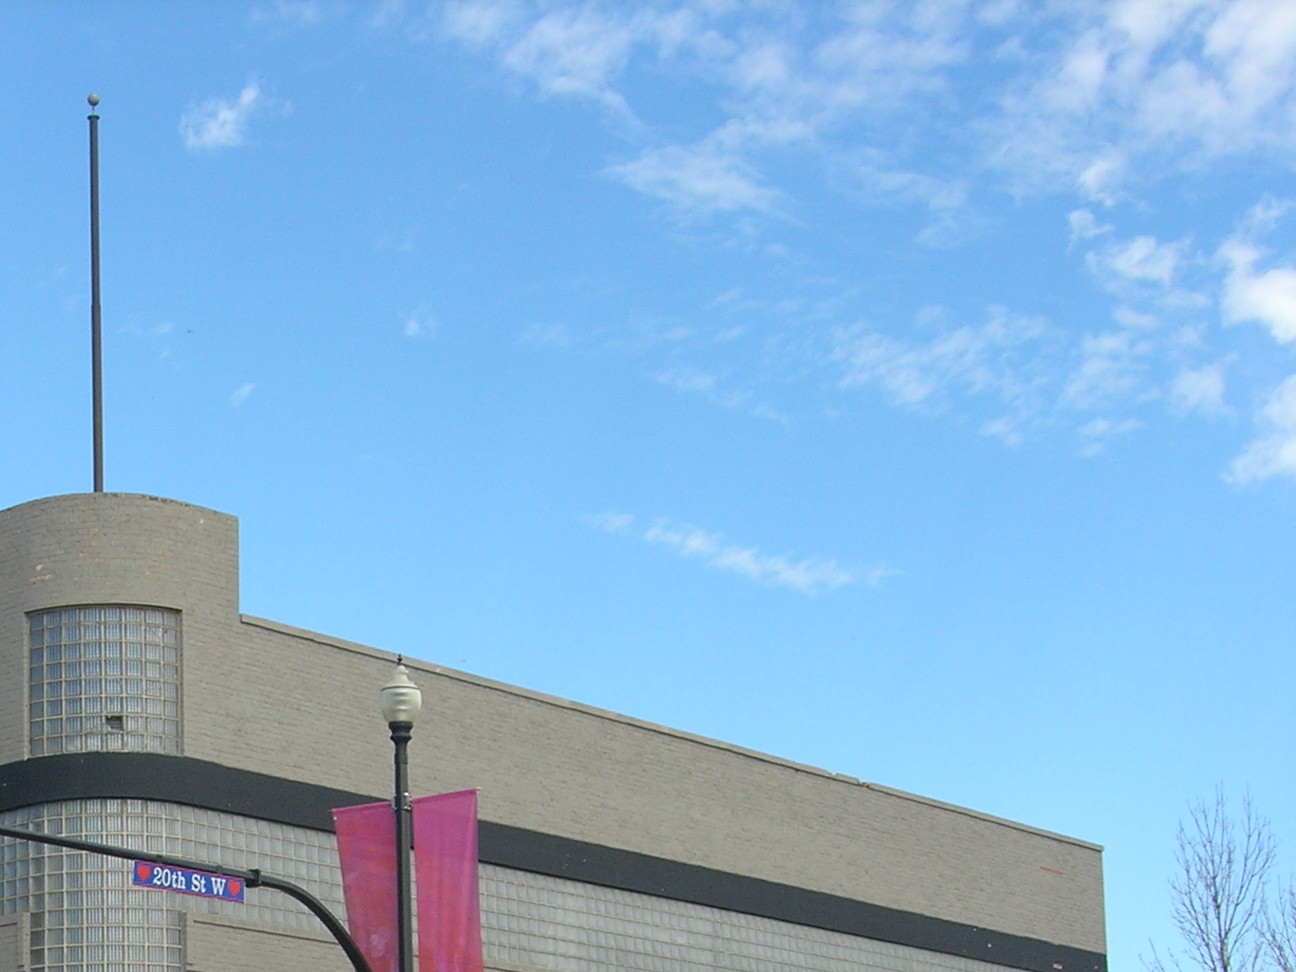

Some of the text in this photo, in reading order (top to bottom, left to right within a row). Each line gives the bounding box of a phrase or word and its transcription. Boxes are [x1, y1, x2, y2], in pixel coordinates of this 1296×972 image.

[152, 867, 226, 896] 20th St W
